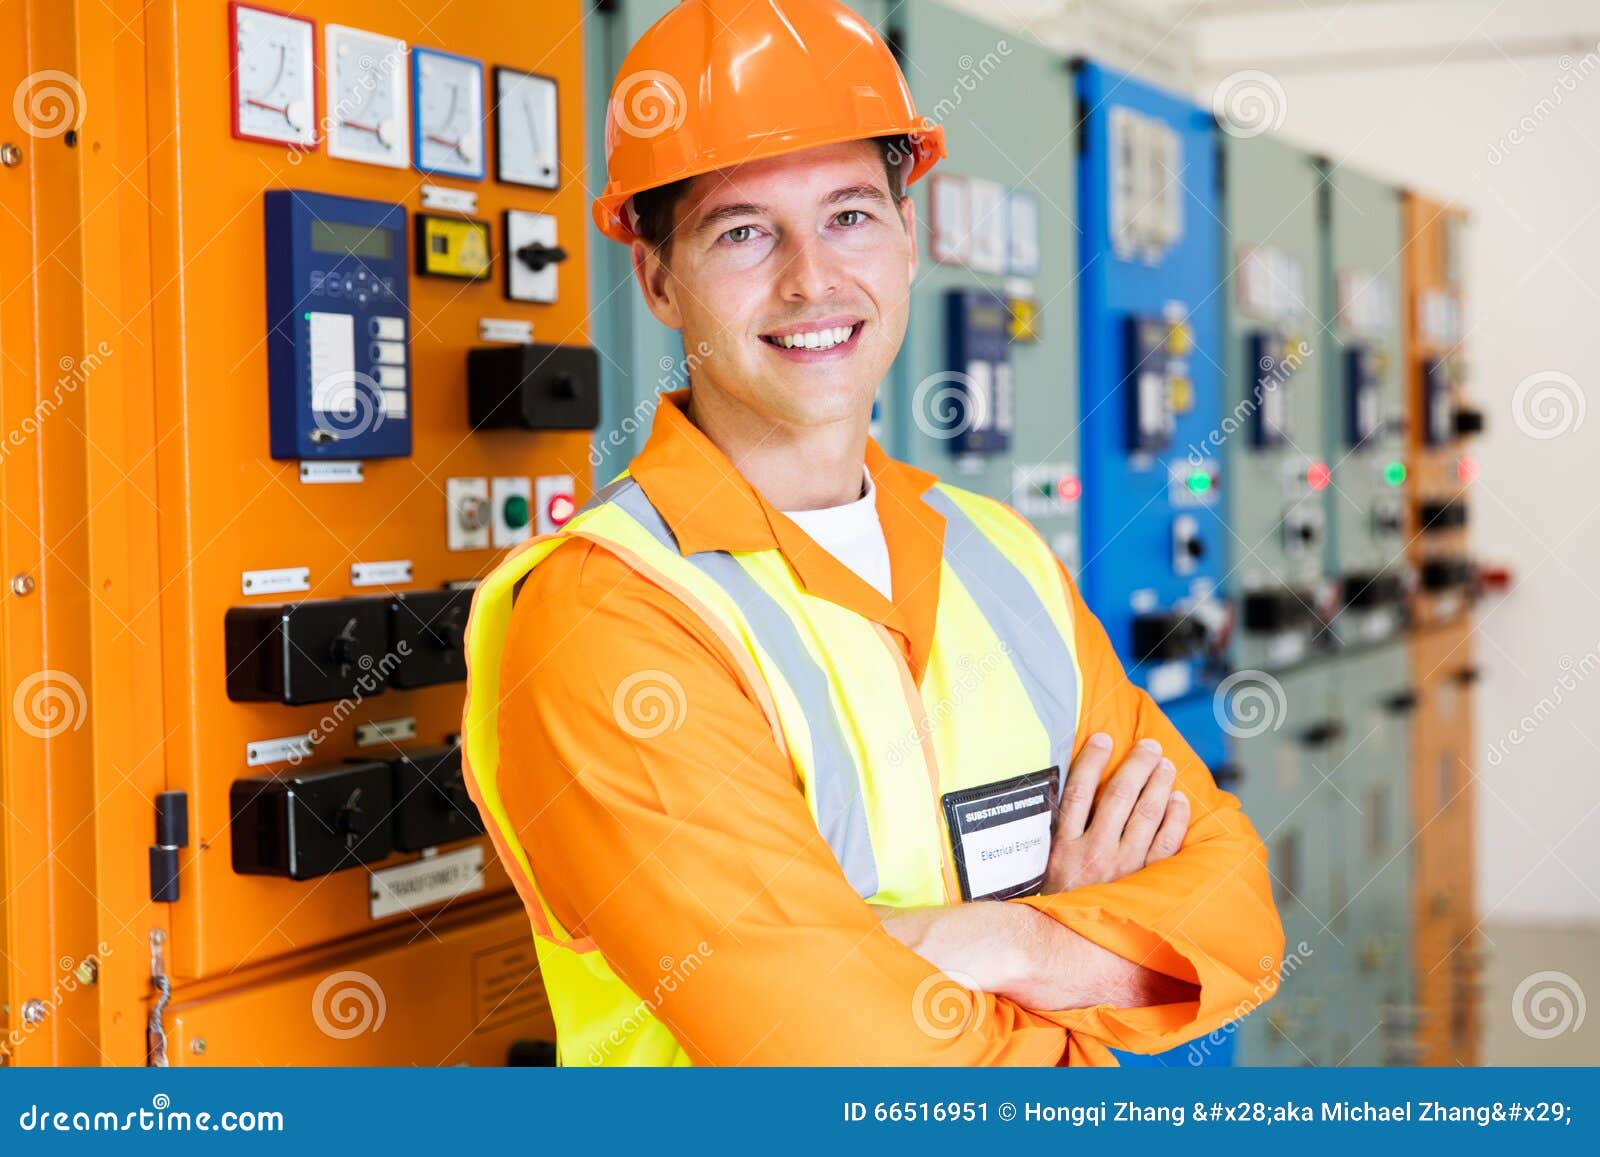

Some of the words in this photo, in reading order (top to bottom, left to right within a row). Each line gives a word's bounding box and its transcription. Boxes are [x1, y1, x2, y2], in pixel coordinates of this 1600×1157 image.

[965, 802, 1013, 822] SUBSTATION
[1014, 795, 1045, 810] DIVISION
[980, 841, 1015, 861] Electrical
